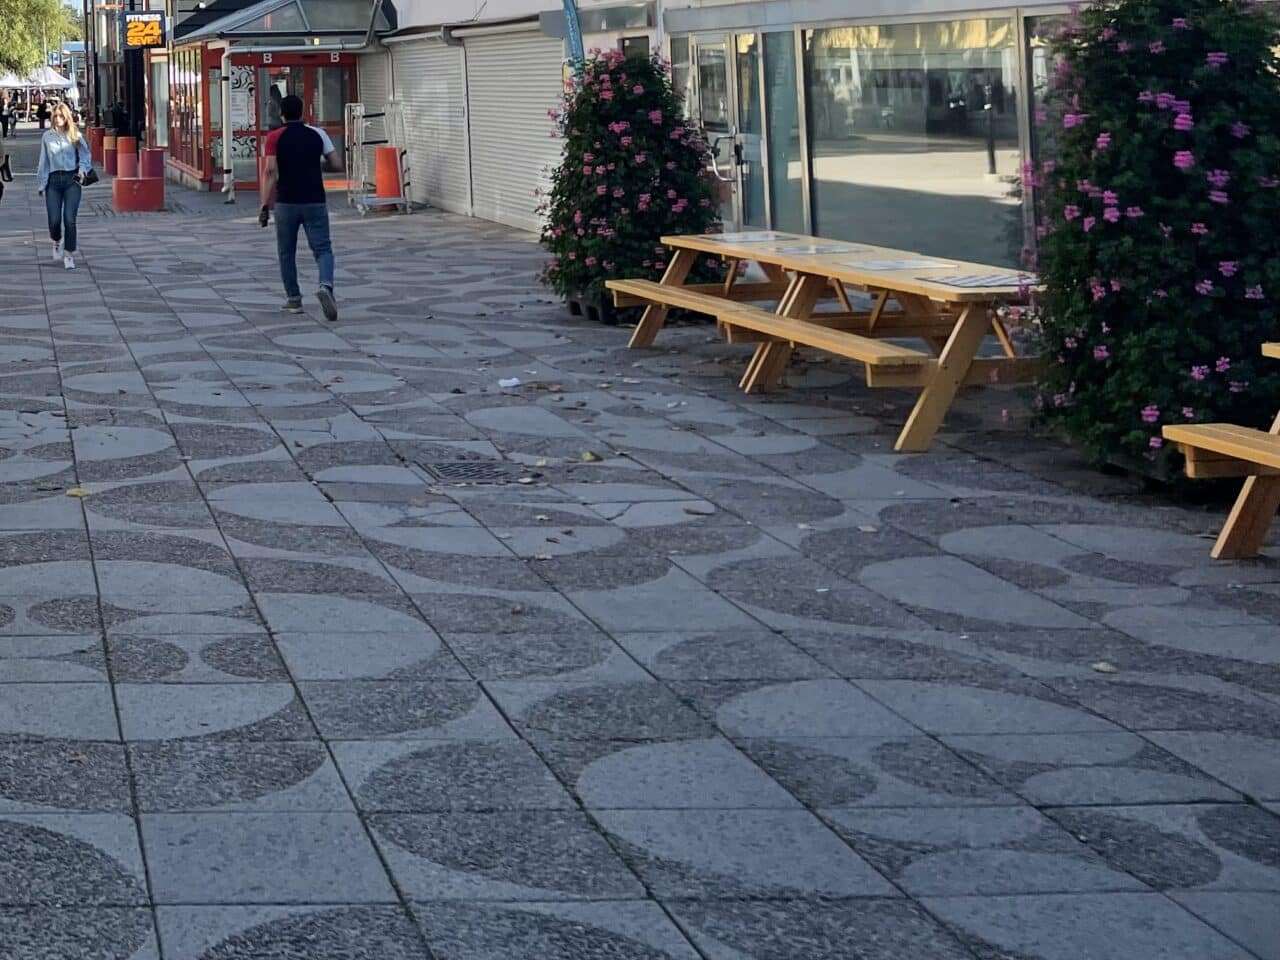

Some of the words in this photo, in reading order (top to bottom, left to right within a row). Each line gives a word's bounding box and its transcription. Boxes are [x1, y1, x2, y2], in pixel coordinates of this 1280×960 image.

[126, 21, 161, 37] 24
[126, 35, 162, 46] SEVEN
[263, 53, 273, 64] B
[330, 52, 340, 63] B
